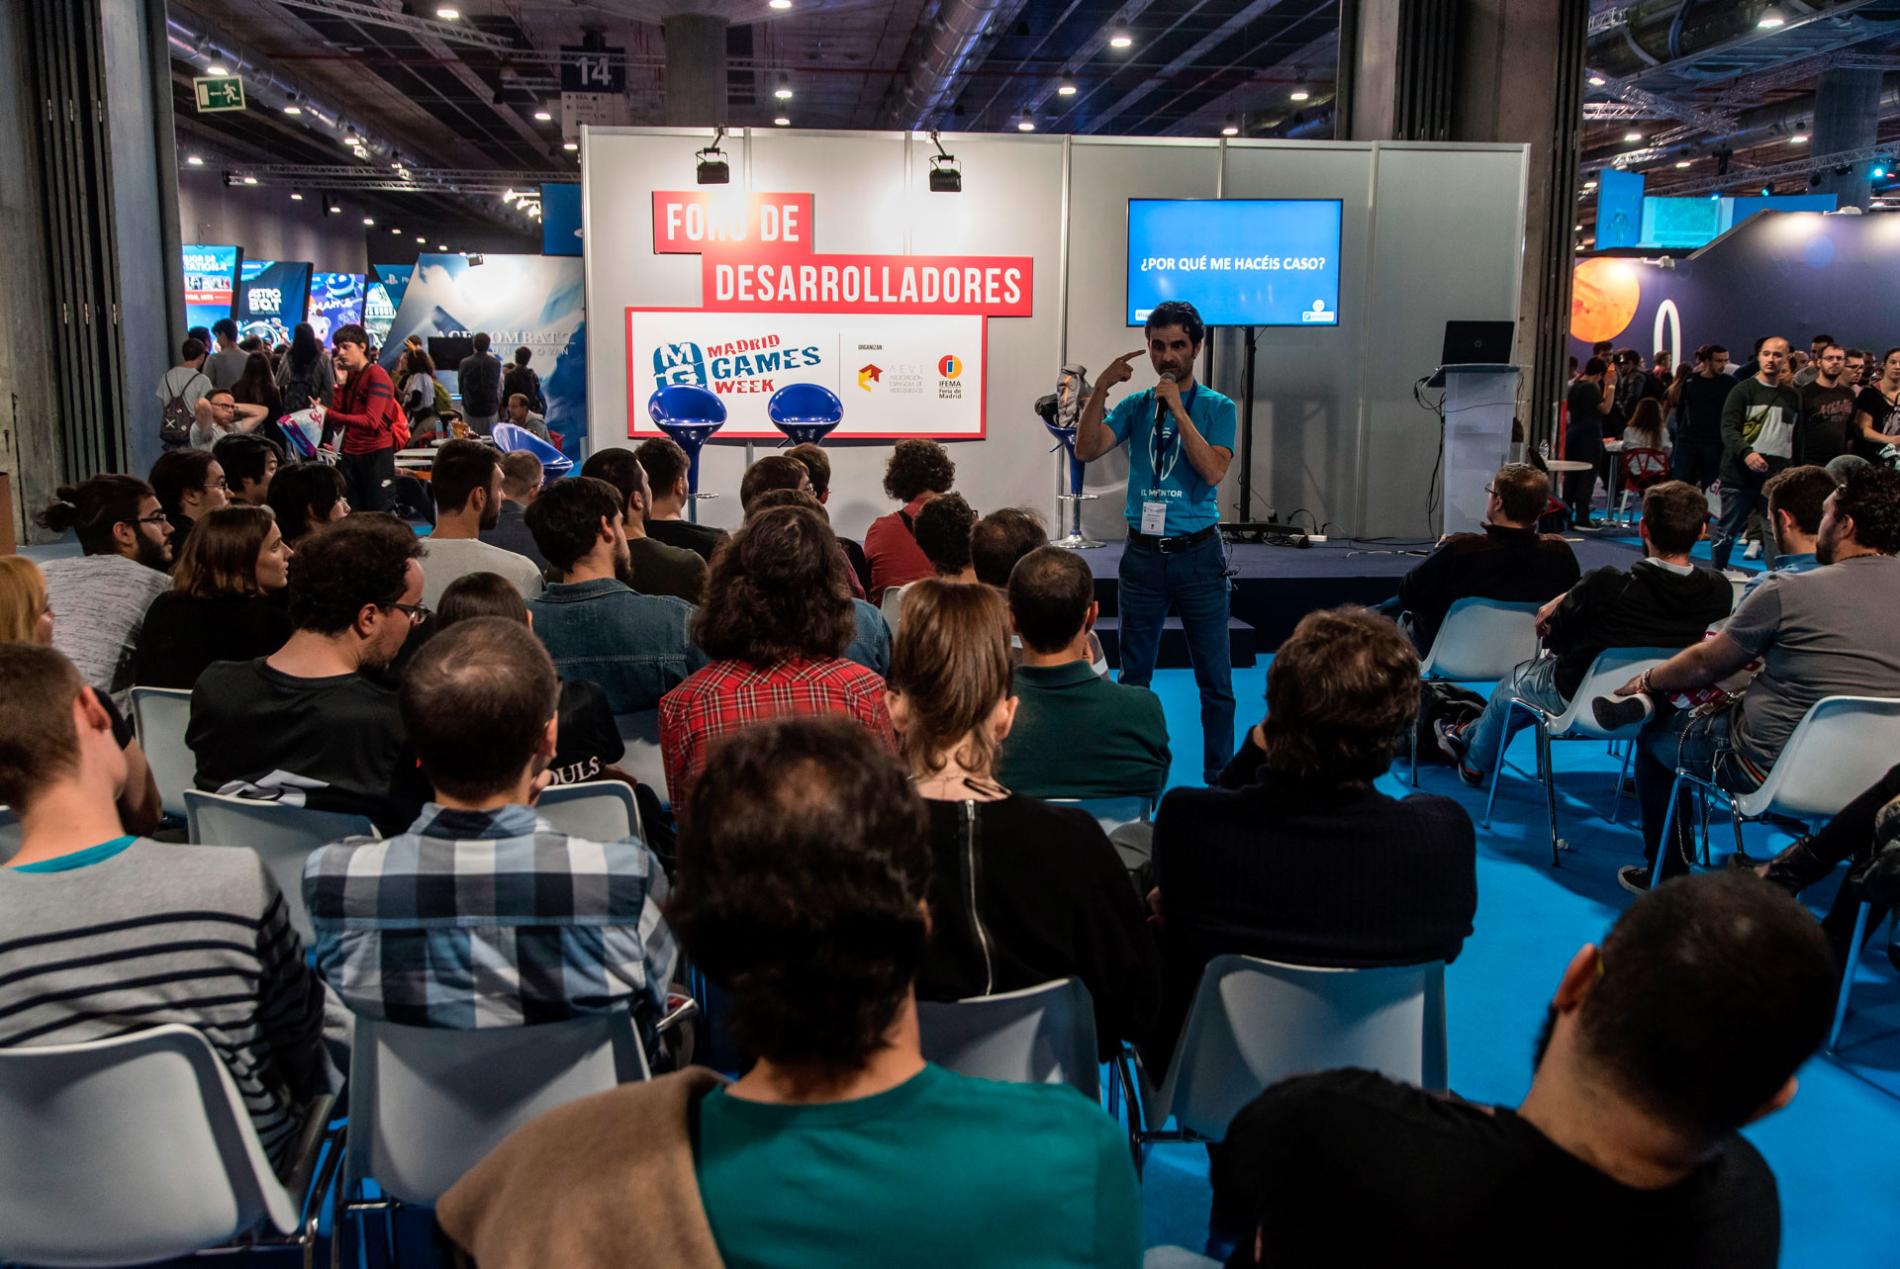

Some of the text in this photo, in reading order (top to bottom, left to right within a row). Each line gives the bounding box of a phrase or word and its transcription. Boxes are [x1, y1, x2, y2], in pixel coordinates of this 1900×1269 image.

[576, 56, 612, 86] 14
[761, 205, 799, 242] DE
[1141, 255, 1326, 271] ¿POR QUÉ ME HACÉIS CASO?
[716, 264, 1021, 304] DESARROLLADORES
[490, 331, 558, 344] OMBAT
[707, 335, 780, 358] MADRID
[711, 346, 821, 380] GAMES
[714, 379, 775, 394] WEEK
